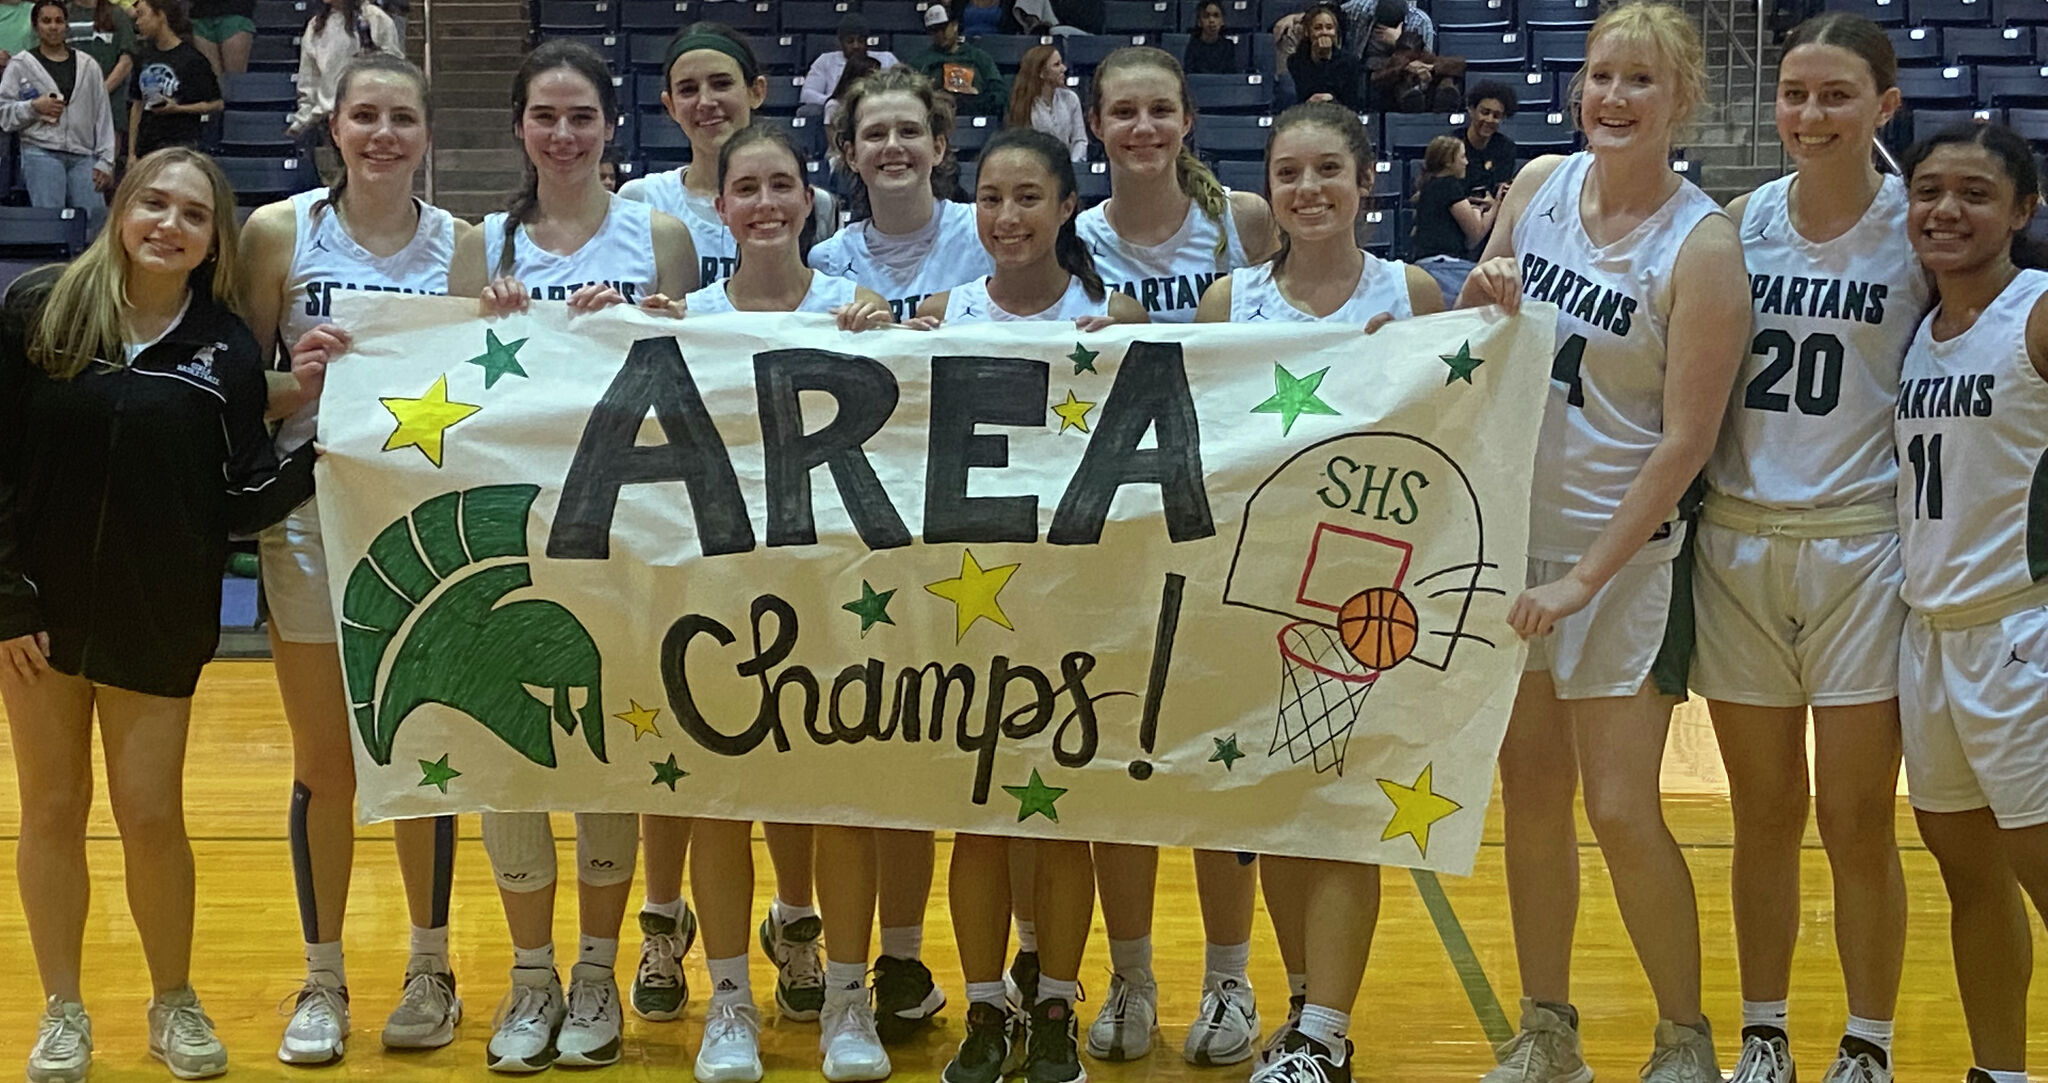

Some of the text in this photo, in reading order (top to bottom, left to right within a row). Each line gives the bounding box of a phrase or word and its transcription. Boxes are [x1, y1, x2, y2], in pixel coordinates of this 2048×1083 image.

[1522, 253, 1637, 337] SPARTANS
[1748, 273, 1888, 324] PARTANS
[1744, 328, 1845, 417] 20
[1896, 374, 1995, 420] ARTANS
[546, 335, 1217, 559] AREA
[1908, 433, 1943, 520] 11
[1316, 456, 1430, 525] SHS
[660, 572, 1186, 805] Champs!
